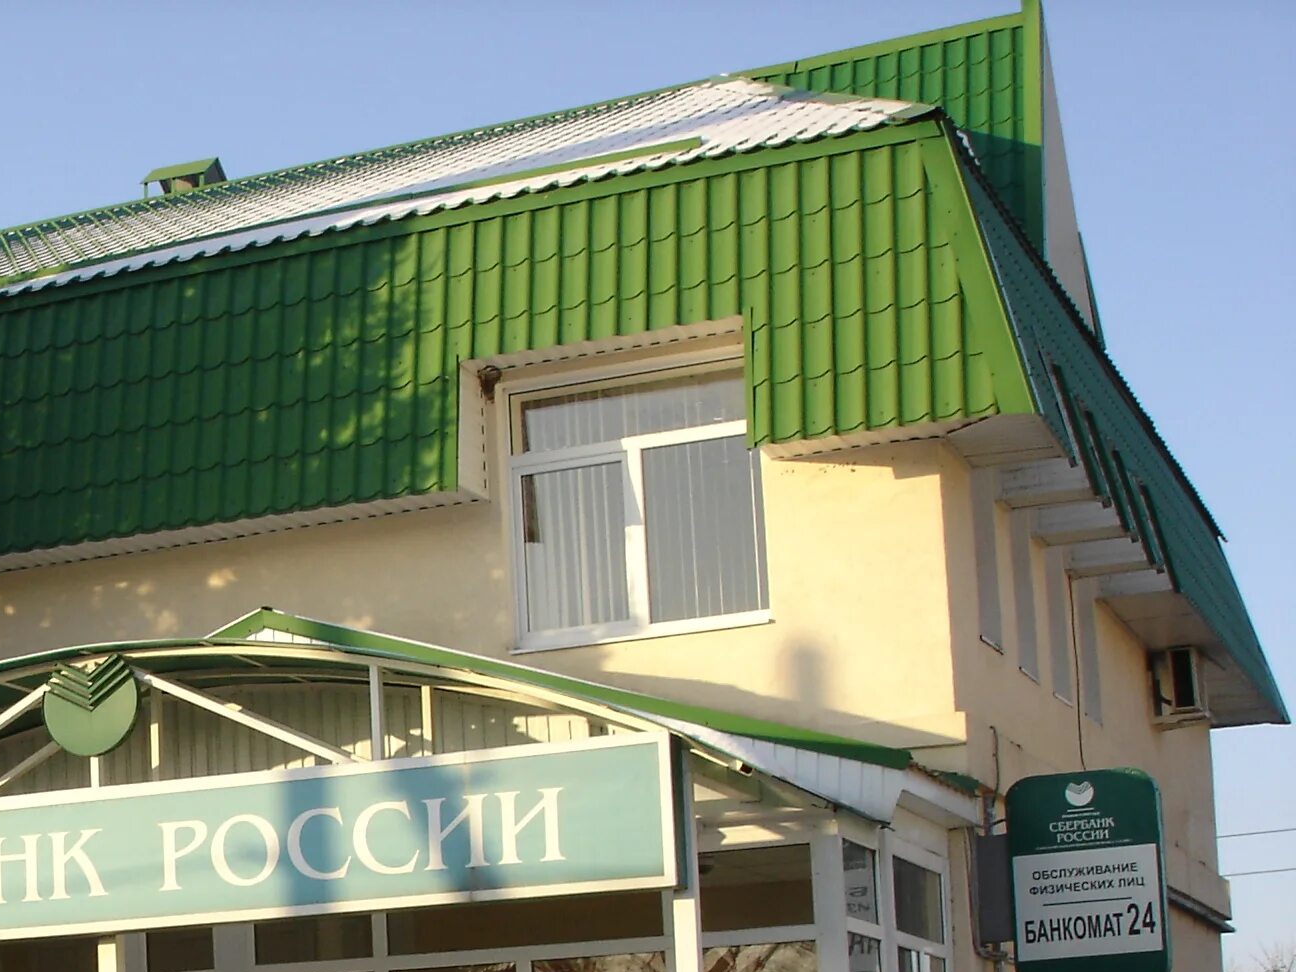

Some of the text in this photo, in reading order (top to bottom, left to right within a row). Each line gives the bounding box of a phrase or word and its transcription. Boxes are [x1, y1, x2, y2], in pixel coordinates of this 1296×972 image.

[1049, 816, 1115, 833] СБЕРБАНК
[157, 786, 567, 892] РОССИИ
[1056, 829, 1110, 843] РОССИИ
[1031, 861, 1139, 881] ОБСЛУЖИВАНИЕ
[1029, 876, 1145, 896] ФИЗИЧЕСКИХ ЛИЦ
[1024, 901, 1157, 944] БАНКОМАТ 24
